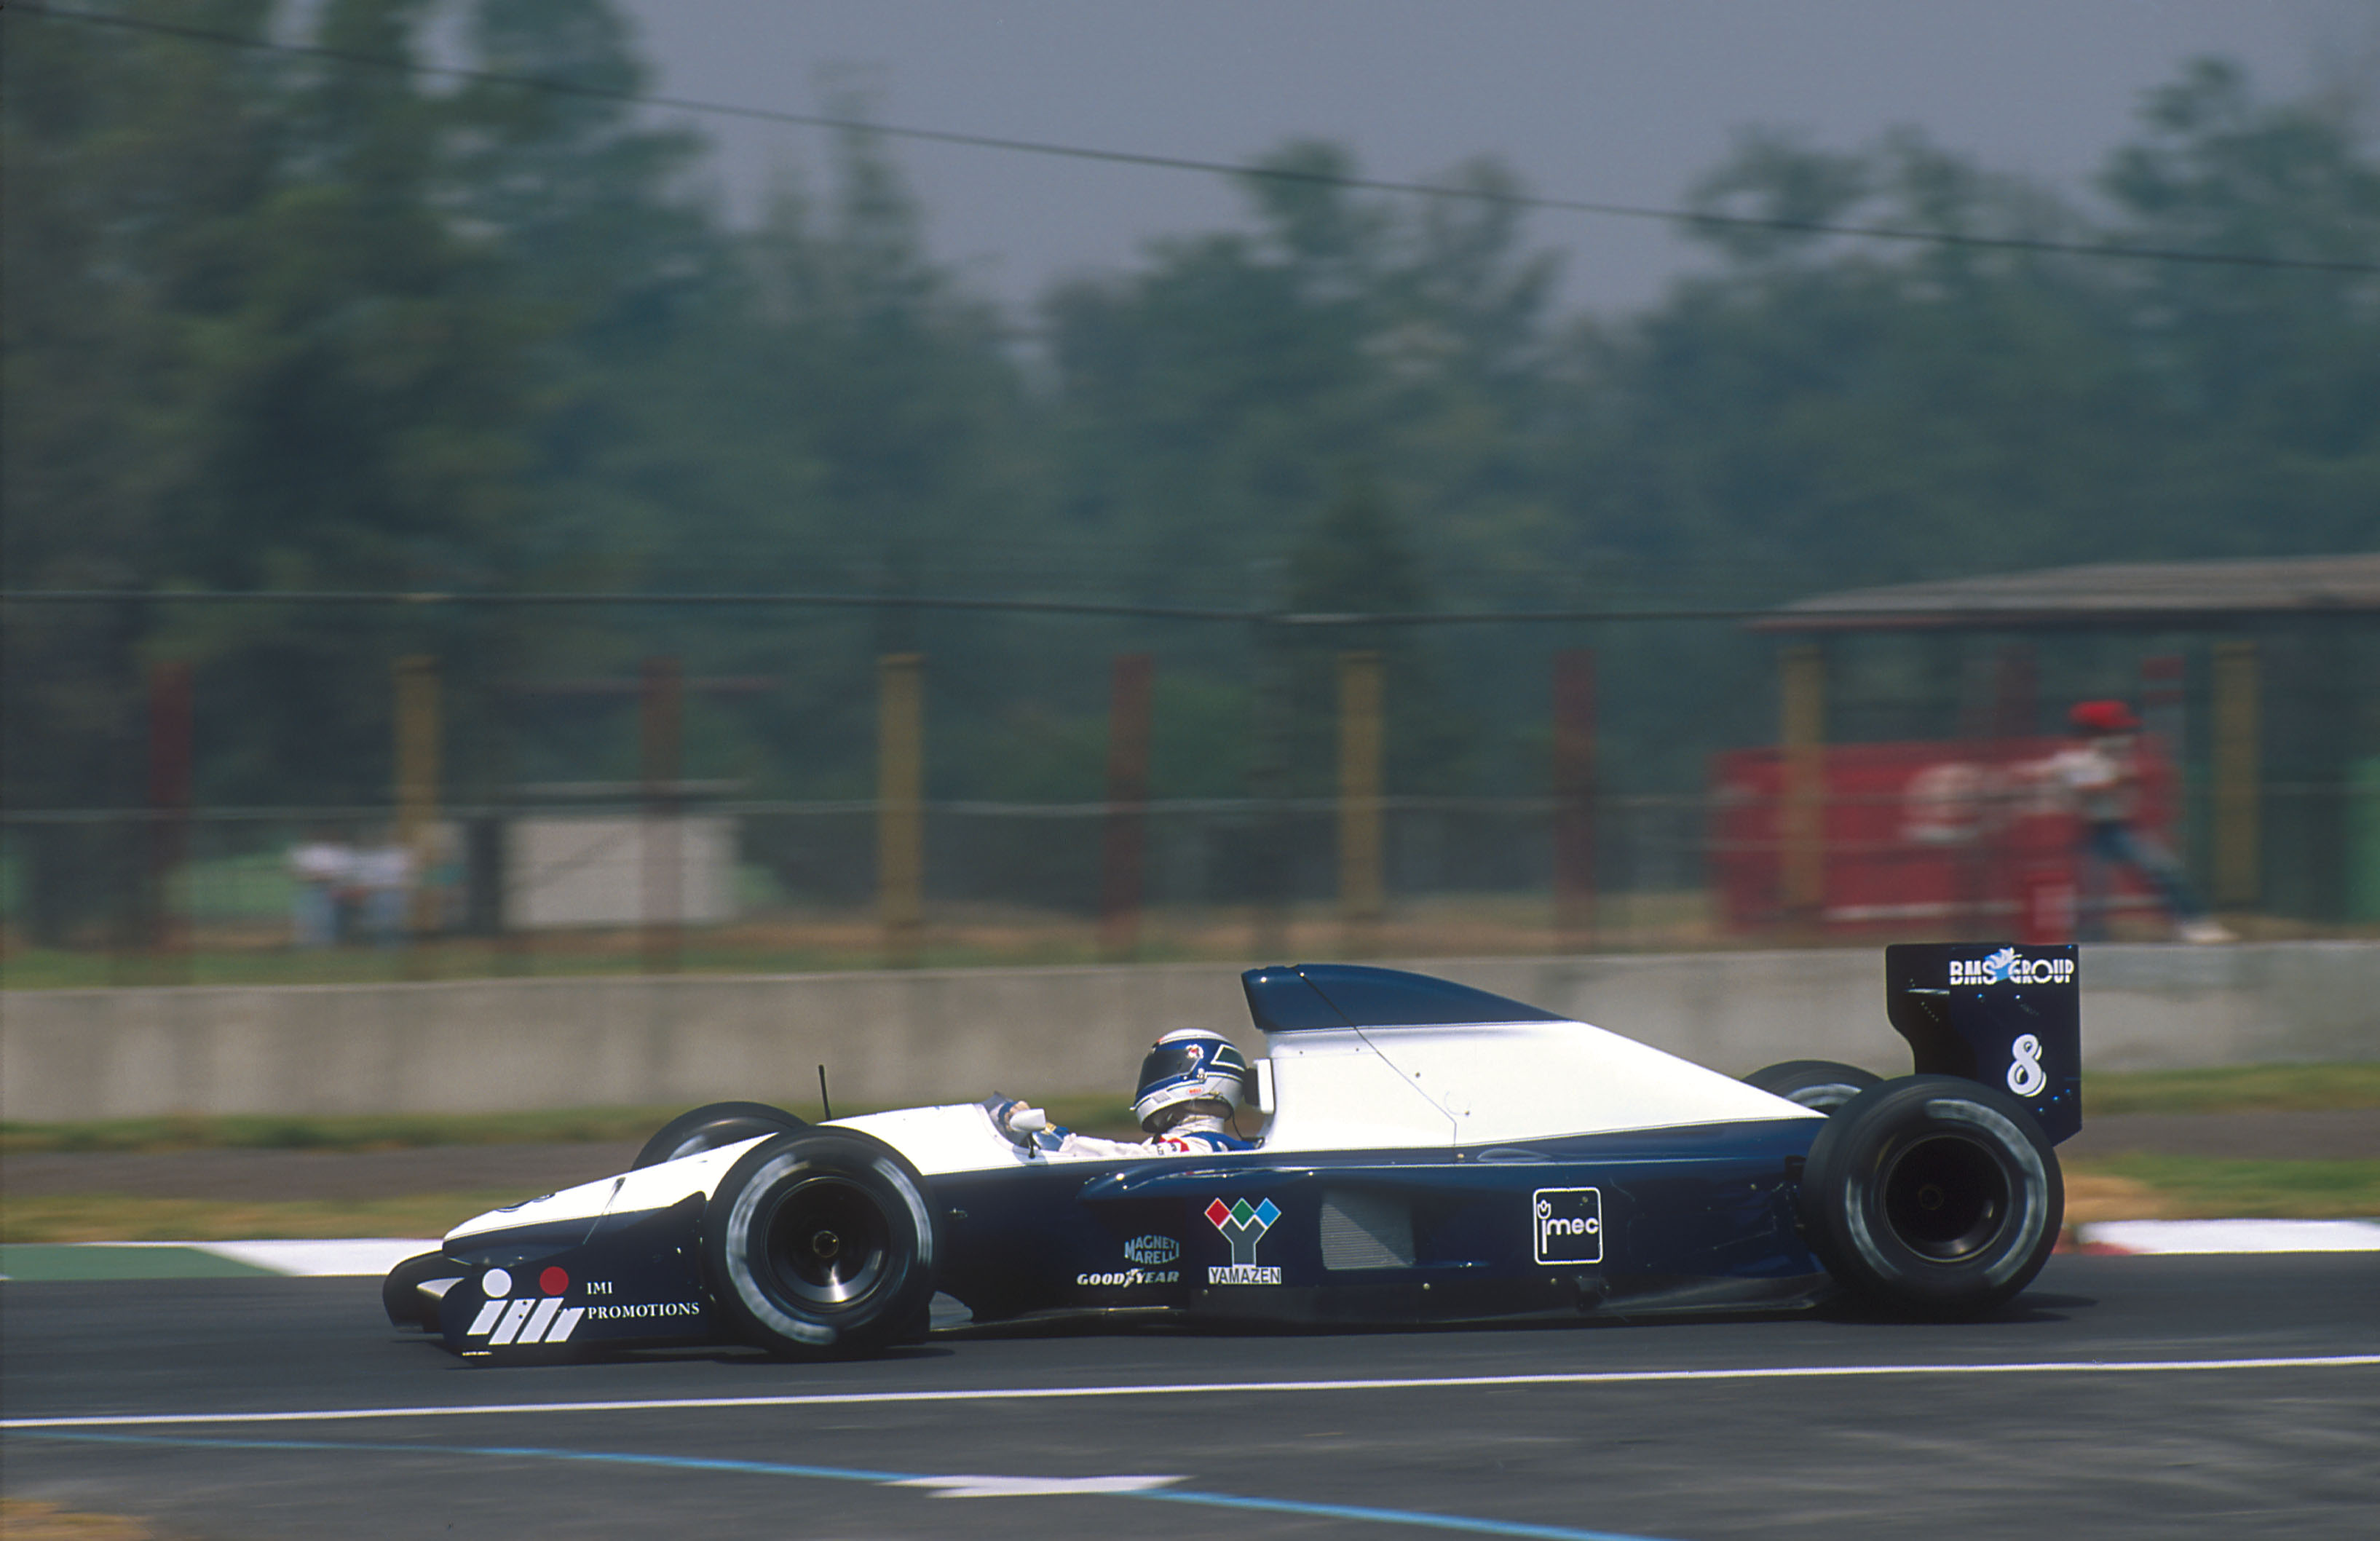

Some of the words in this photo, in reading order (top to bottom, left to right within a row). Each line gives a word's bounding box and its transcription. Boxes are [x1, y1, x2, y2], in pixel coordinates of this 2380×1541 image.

[1950, 959, 1998, 985] BMS
[2008, 959, 2074, 984] GROUP
[2007, 1034, 2047, 1096] 8
[1077, 1268, 1179, 1288] GOODYEAR
[1209, 1267, 1281, 1284] YAMAZEN
[587, 1281, 612, 1294] IMI
[588, 1302, 700, 1320] PROMOTIONS
